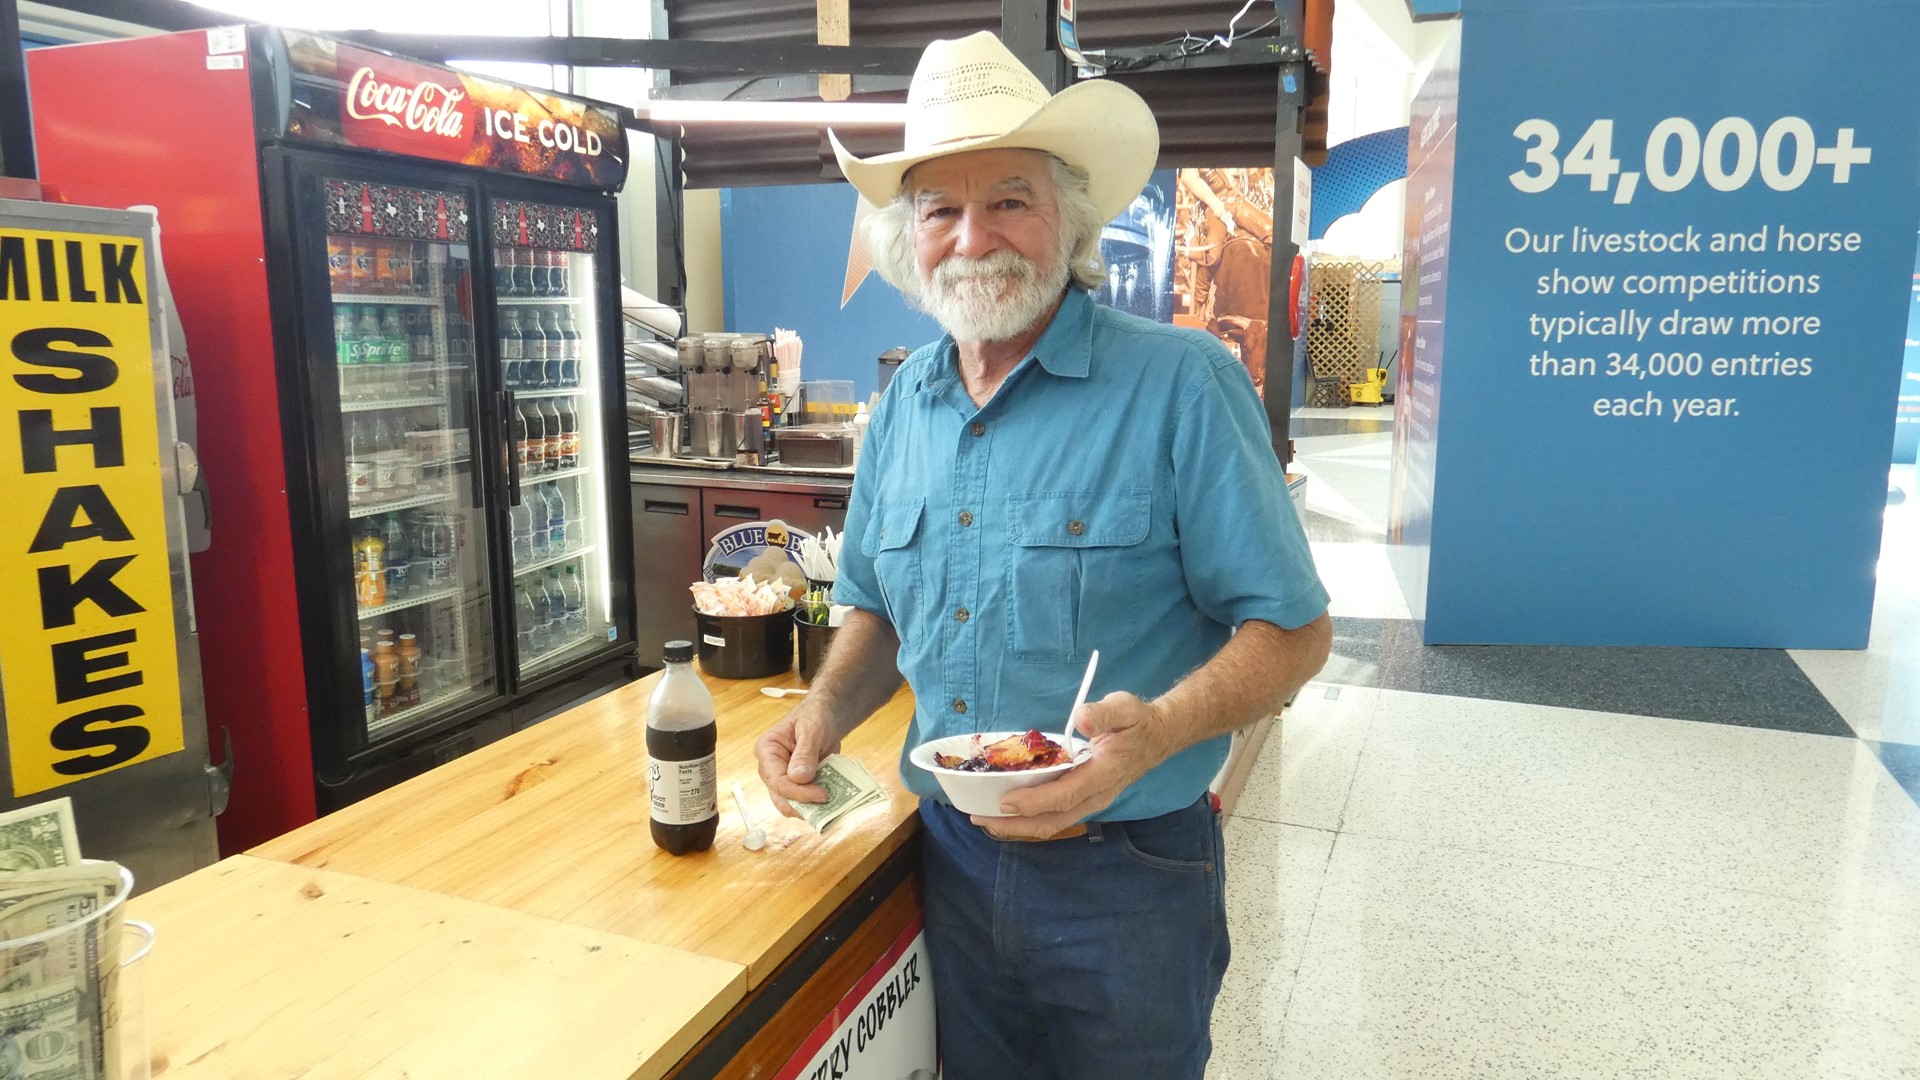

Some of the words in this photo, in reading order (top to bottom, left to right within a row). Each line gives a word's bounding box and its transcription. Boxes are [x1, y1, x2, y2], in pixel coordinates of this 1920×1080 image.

[347, 67, 464, 138] Coca-Cola
[485, 107, 529, 143] ICE
[538, 120, 602, 156] COLD
[1508, 116, 1872, 205] 34,000+
[1505, 227, 1564, 254] Our
[1572, 226, 1702, 253] livestock
[1709, 225, 1768, 253] and
[1777, 225, 1862, 252] horse
[0, 236, 143, 304] MILK
[1536, 269, 1615, 295] show
[1622, 268, 1820, 302] competitions
[1529, 309, 1652, 344] typically
[1659, 309, 1734, 336] draw
[1742, 316, 1821, 336] more
[1529, 351, 1596, 377] than
[1605, 352, 1703, 380] 34,000
[1710, 351, 1813, 377] entries
[1593, 391, 1663, 417] each
[1672, 397, 1740, 423] year.
[11, 327, 150, 776] SHAKES
[720, 529, 764, 554] BLUE
[811, 1028, 852, 1080] RRY
[857, 953, 921, 1053] COBBLER
